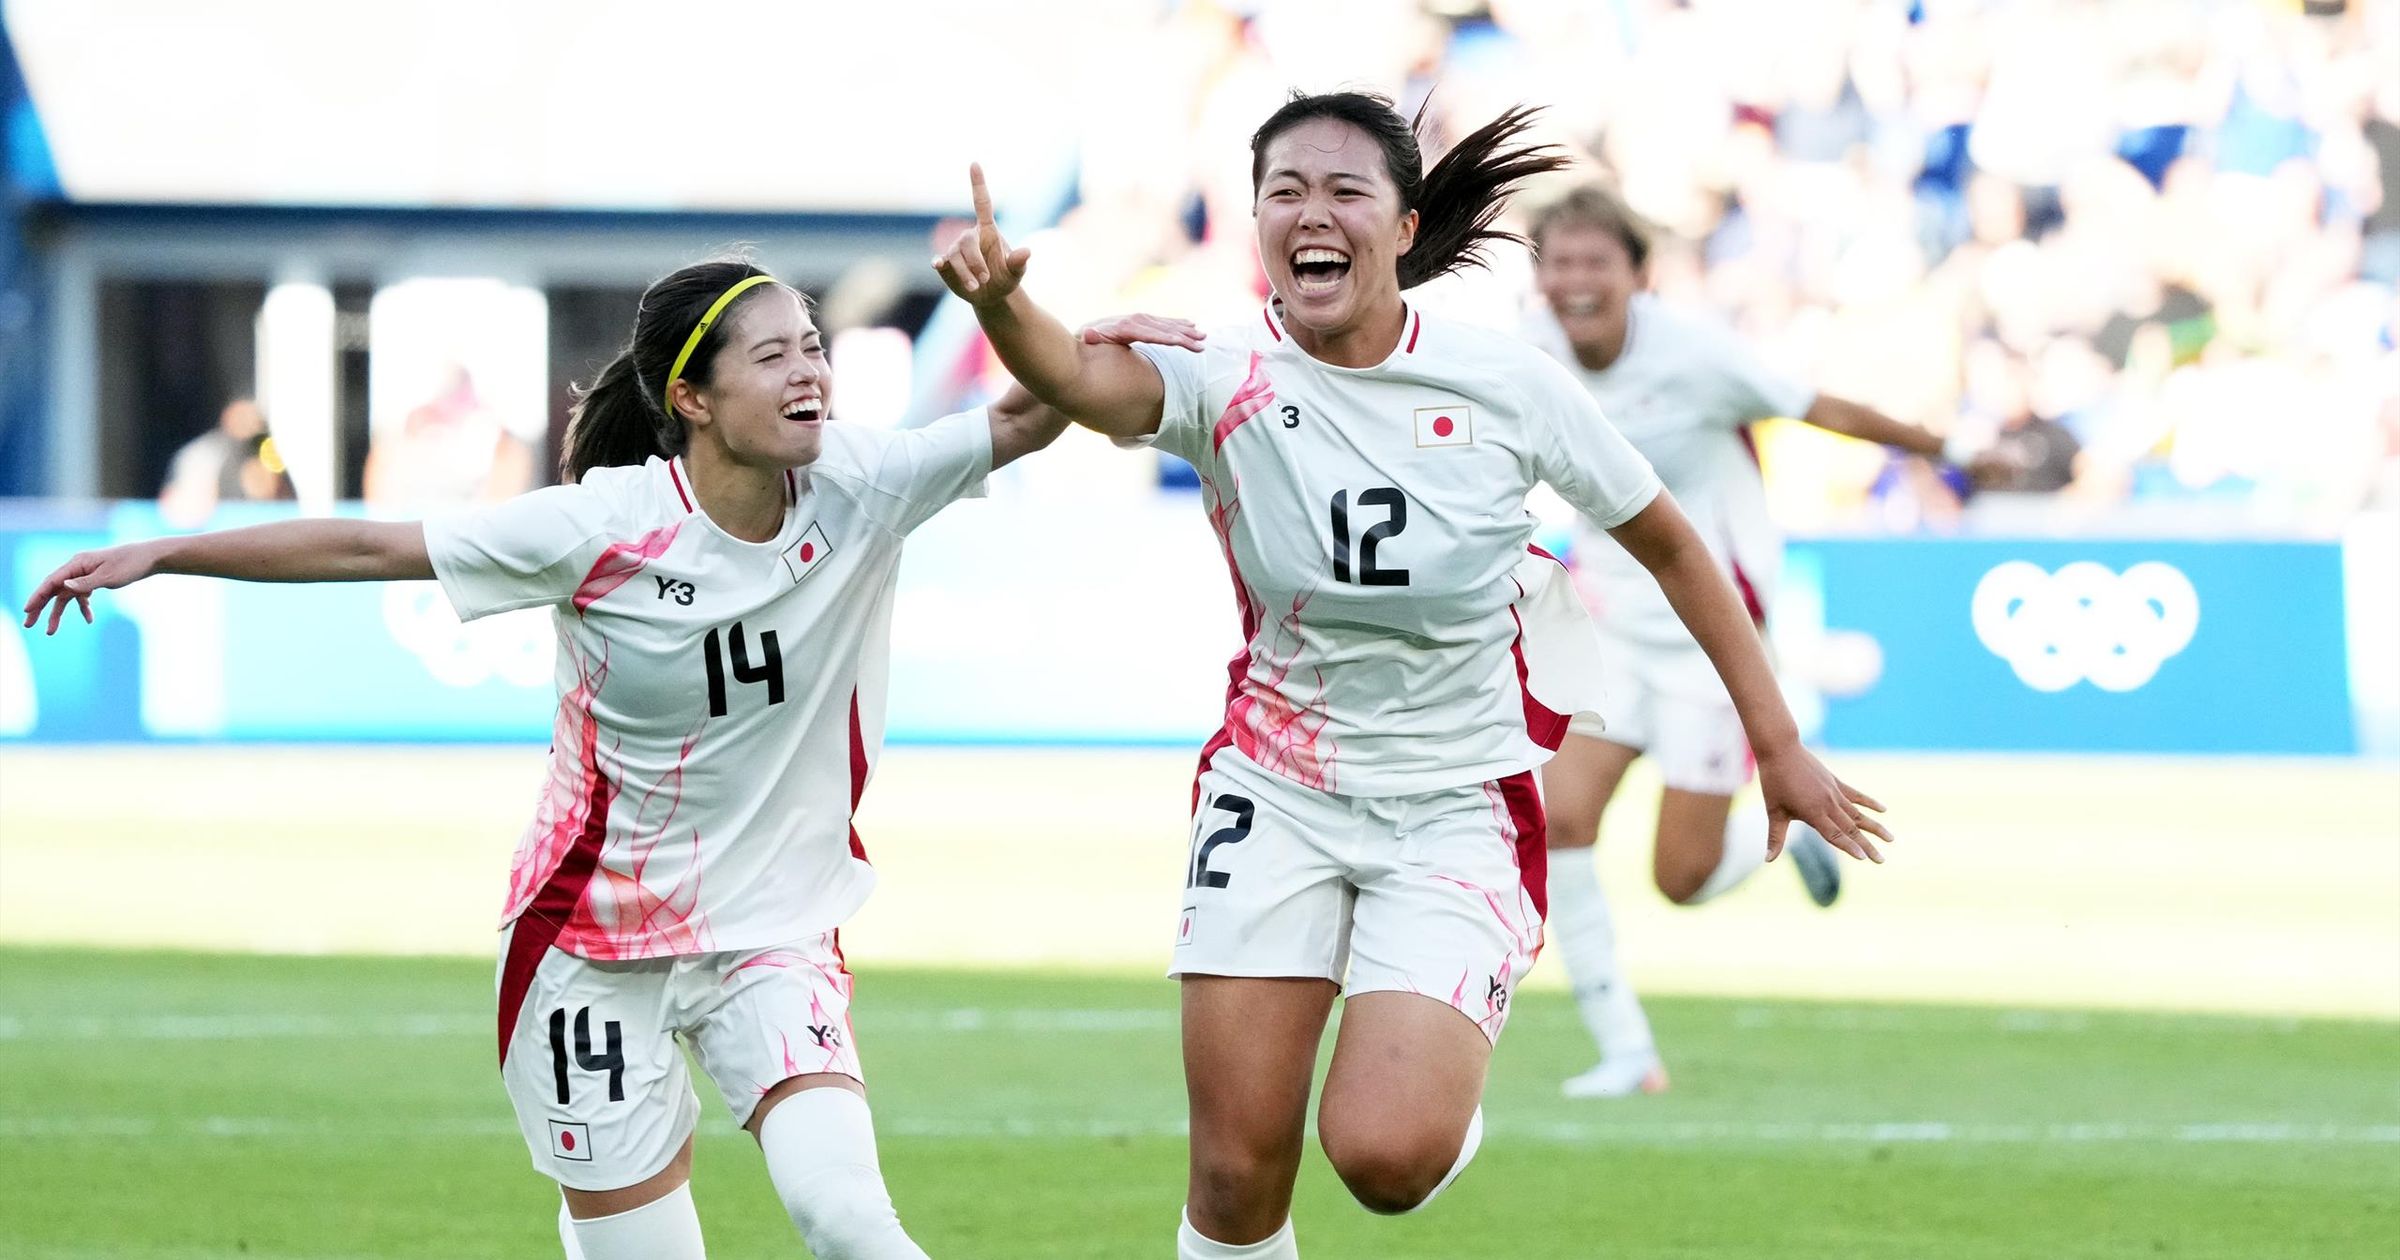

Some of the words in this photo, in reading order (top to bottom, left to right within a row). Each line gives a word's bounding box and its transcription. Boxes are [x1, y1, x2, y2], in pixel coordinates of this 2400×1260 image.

[1330, 487, 1410, 587] 12
[655, 575, 696, 606] Y-3
[704, 621, 785, 718] 14
[549, 1006, 625, 1105] 14
